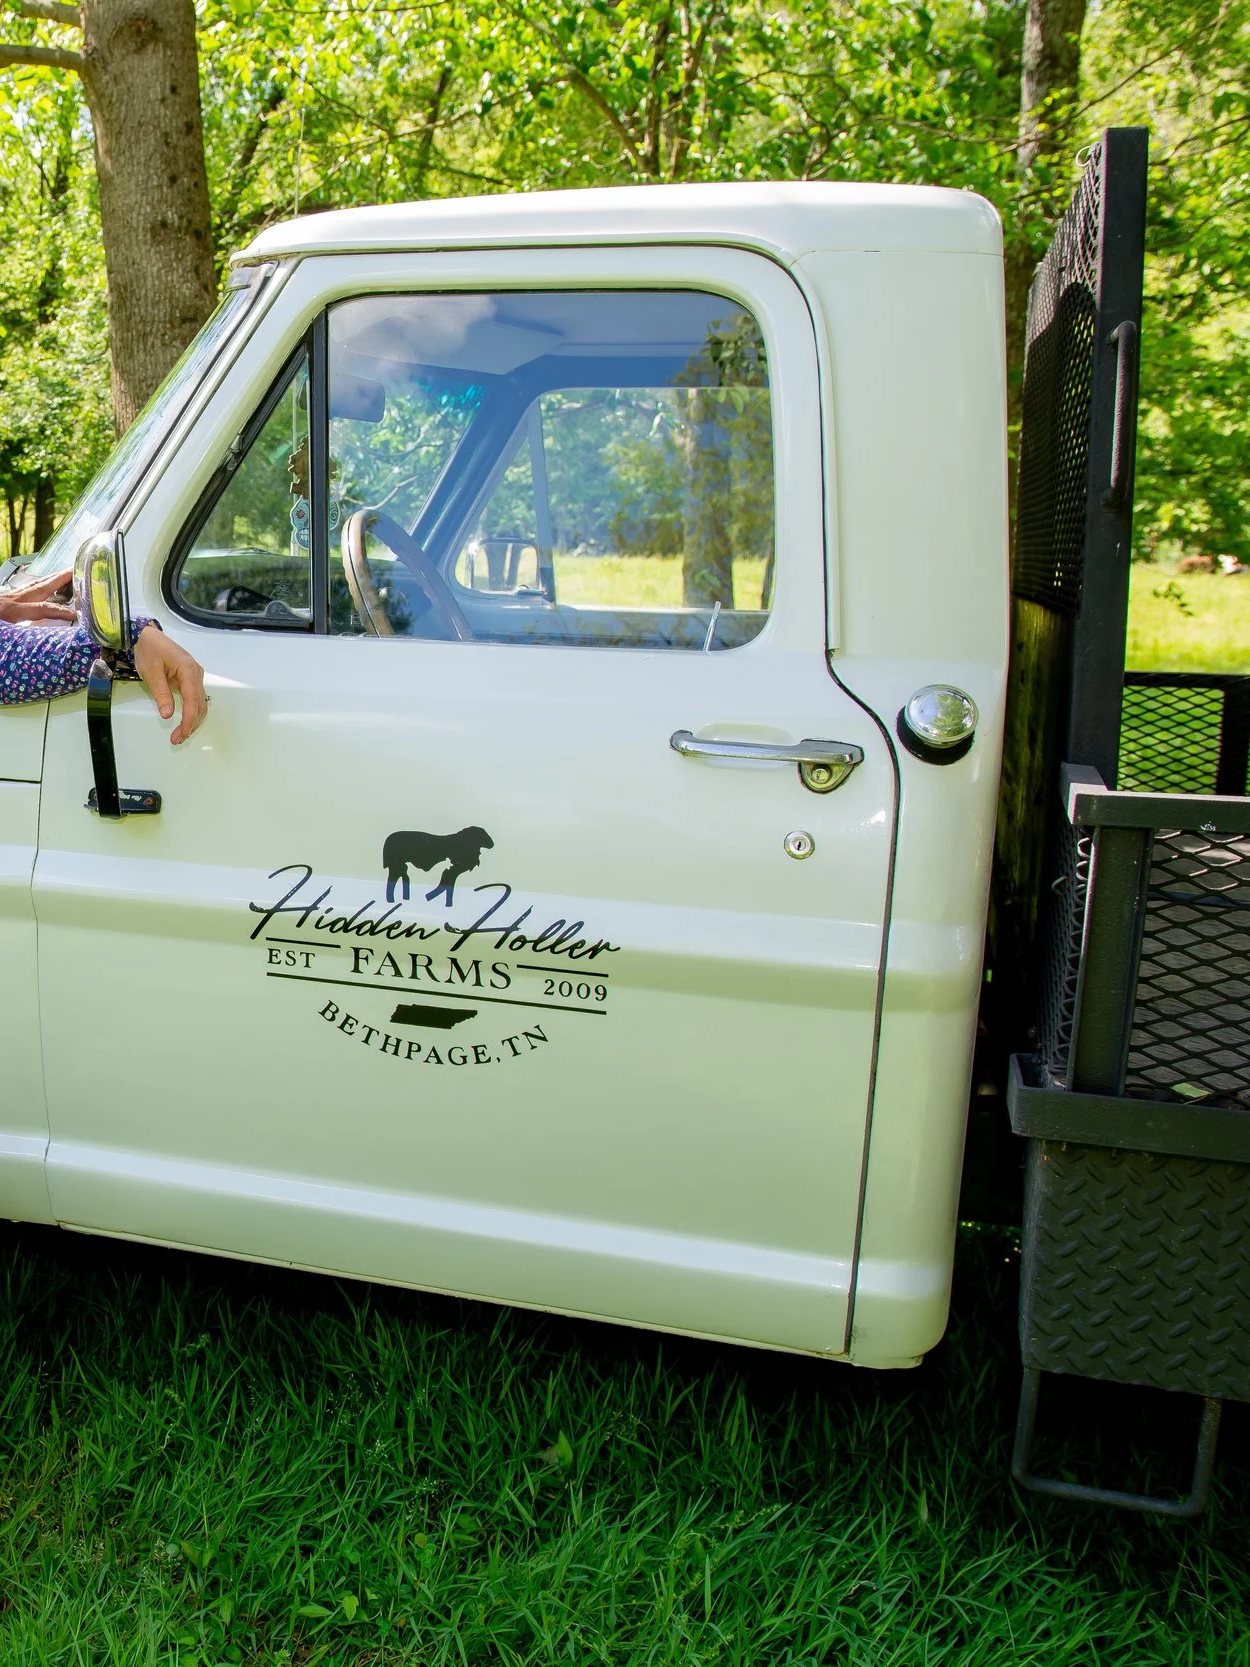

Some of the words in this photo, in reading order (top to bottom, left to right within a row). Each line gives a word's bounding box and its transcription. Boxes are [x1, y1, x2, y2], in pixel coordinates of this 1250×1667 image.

[249, 864, 440, 940] Hidden
[444, 883, 621, 960] Holler
[266, 947, 316, 969] EST
[349, 946, 511, 990] FARMS
[543, 978, 608, 1002] 2009
